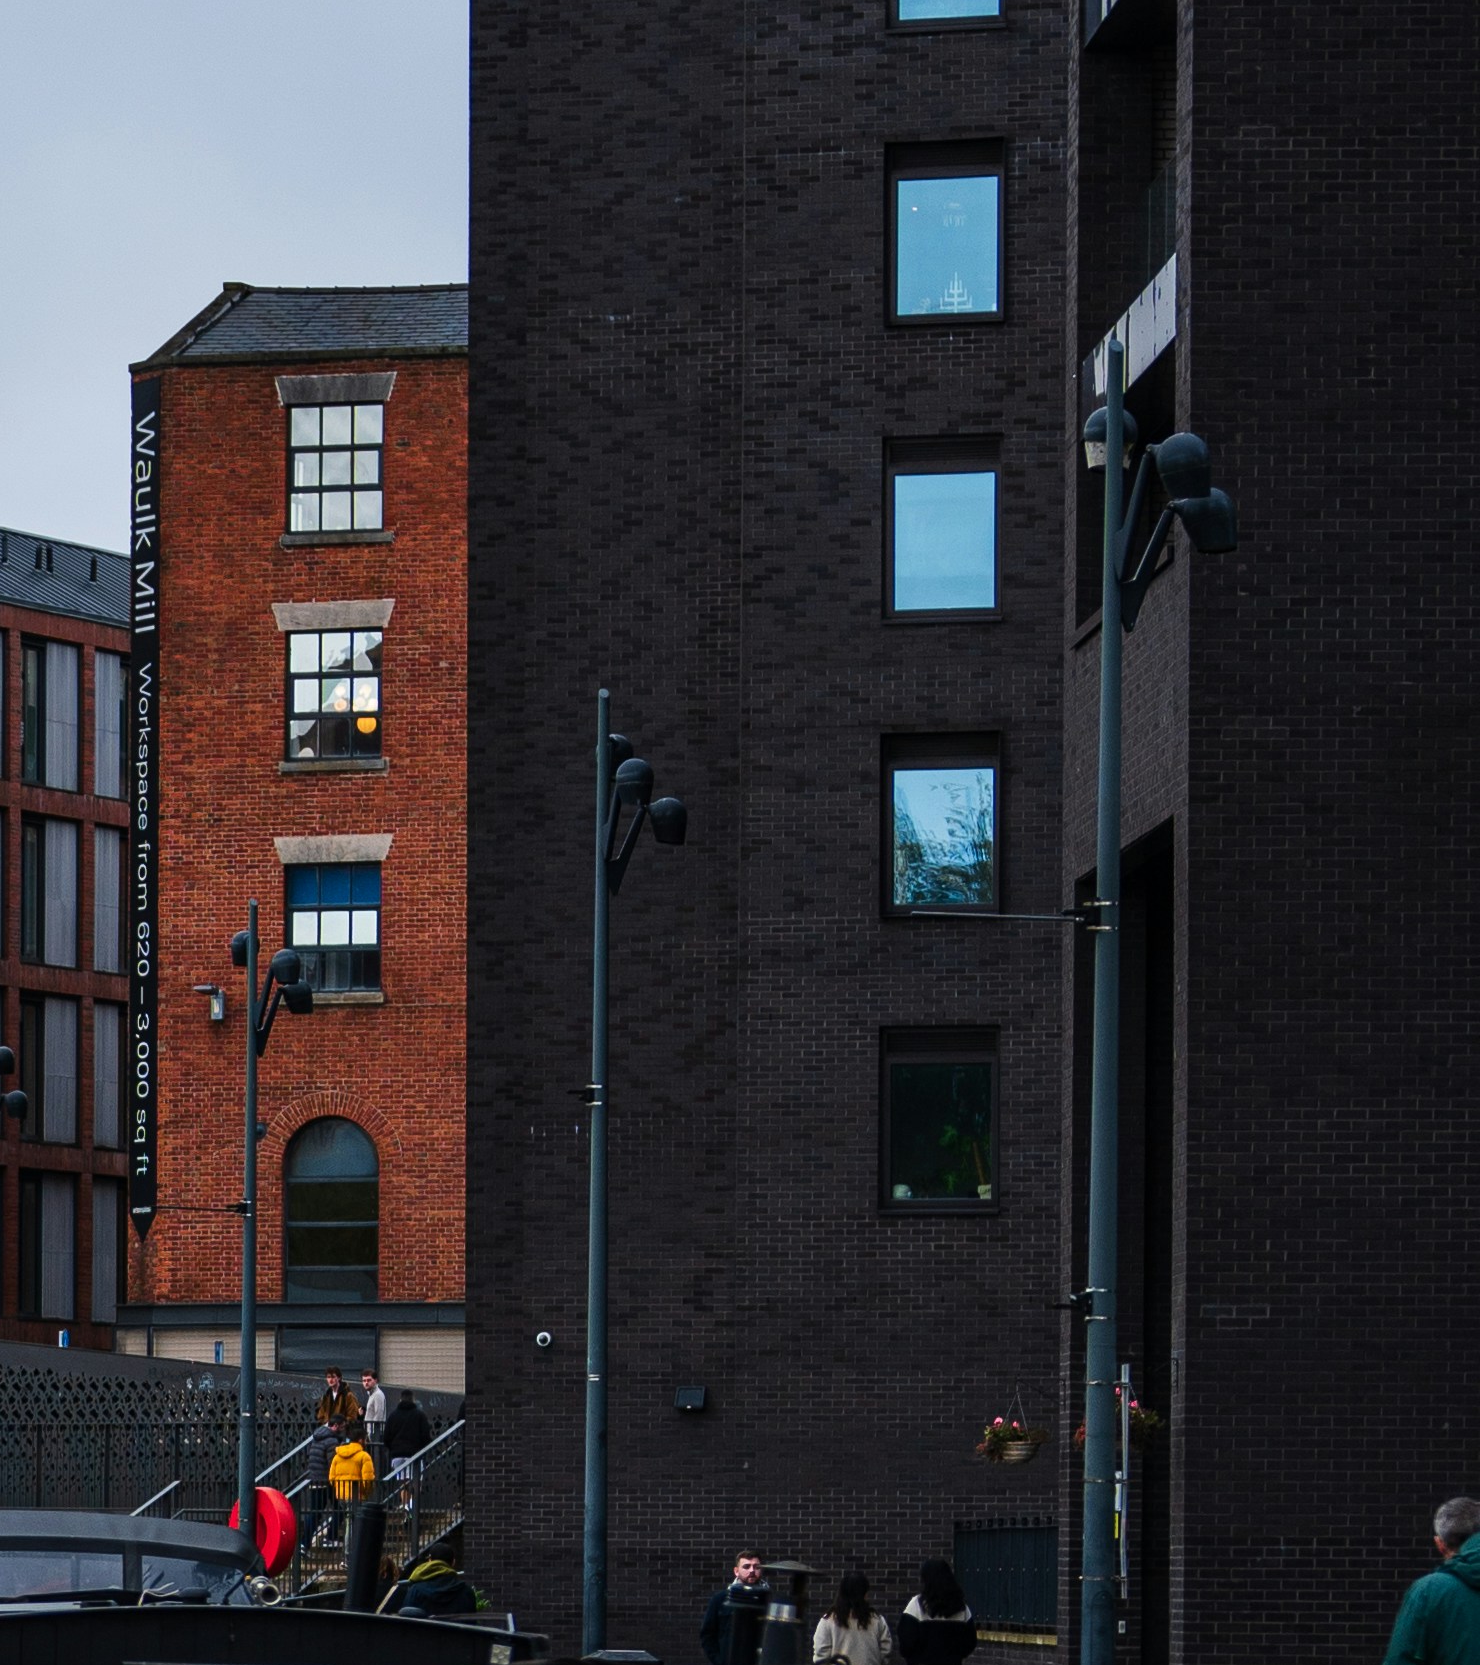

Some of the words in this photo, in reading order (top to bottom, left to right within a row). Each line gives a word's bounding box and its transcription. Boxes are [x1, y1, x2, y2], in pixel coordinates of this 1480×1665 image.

[135, 410, 156, 551] Waulk
[134, 560, 156, 634] Mill
[135, 662, 152, 830] Workspace
[137, 839, 151, 911] from
[136, 921, 150, 977] 620
[135, 1013, 150, 1099] 3,000
[133, 1109, 146, 1143] sq
[136, 1153, 150, 1176] ft
